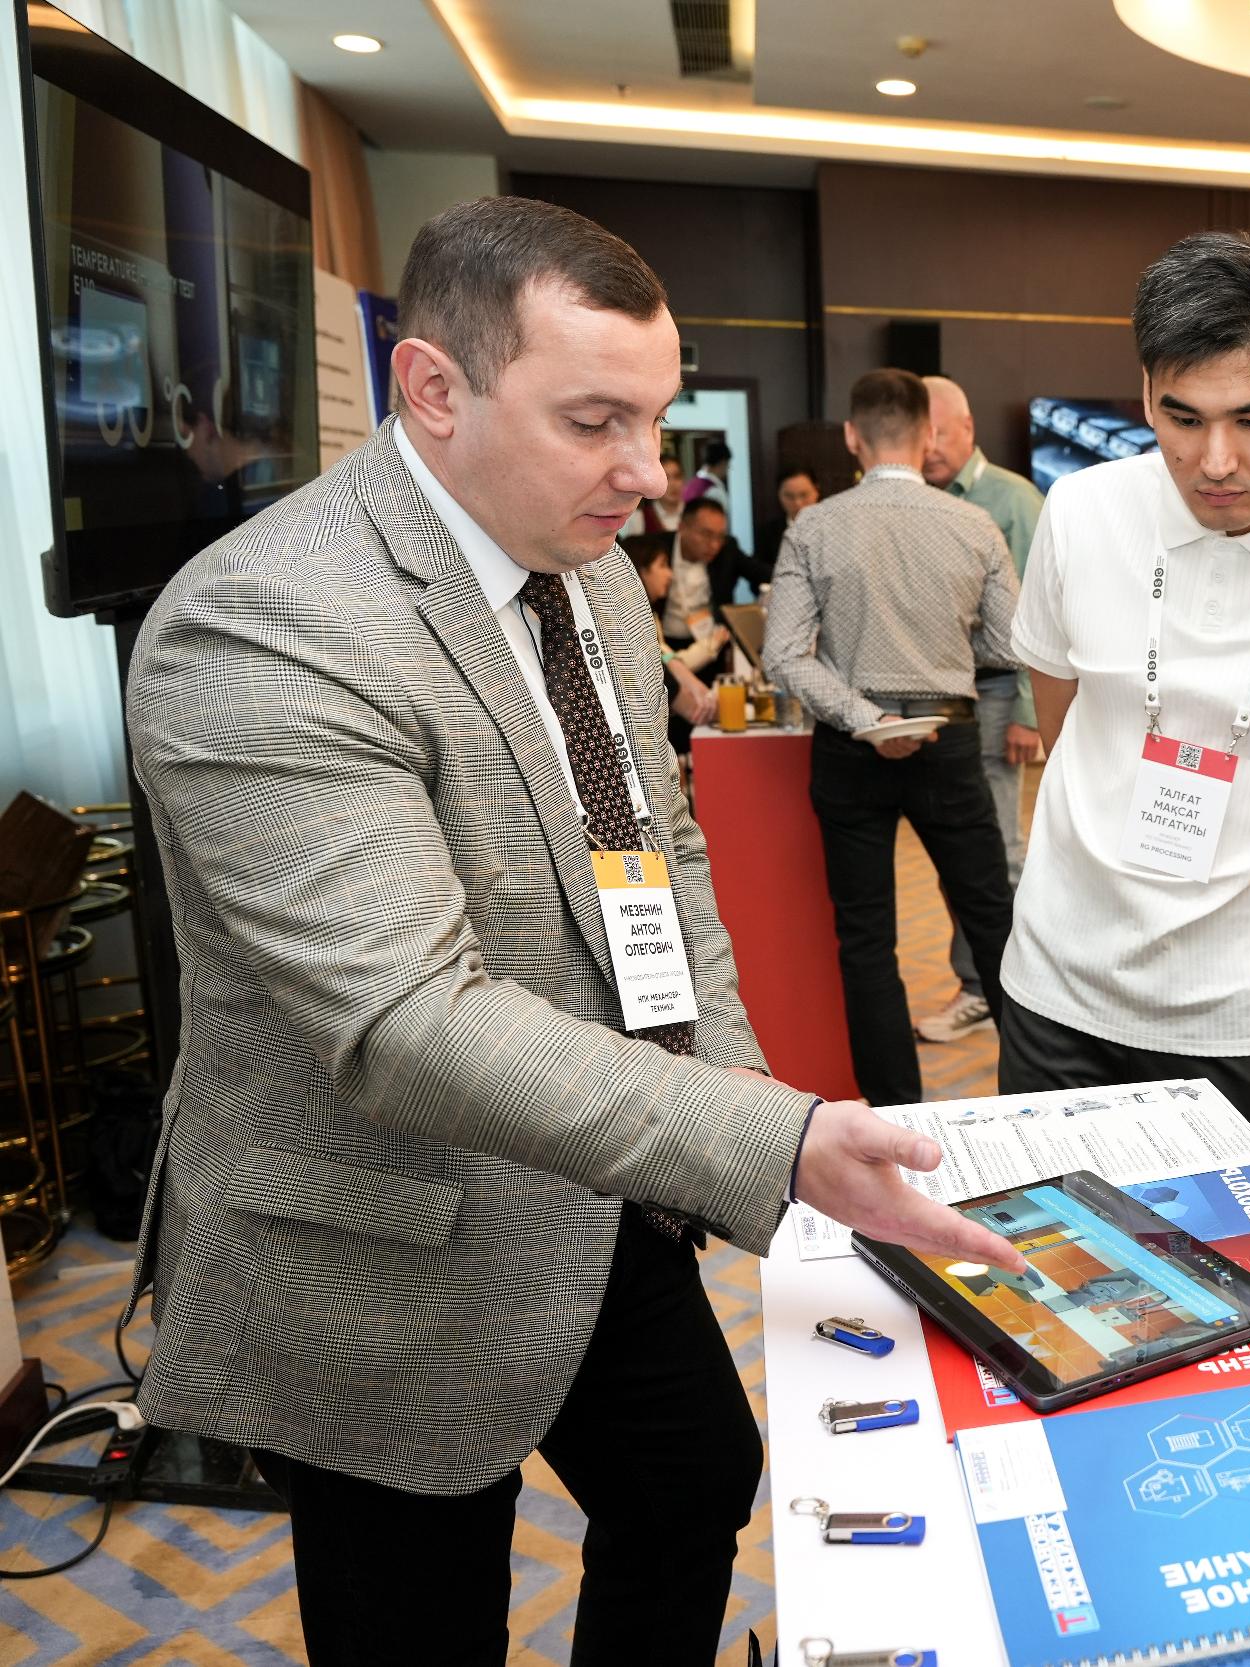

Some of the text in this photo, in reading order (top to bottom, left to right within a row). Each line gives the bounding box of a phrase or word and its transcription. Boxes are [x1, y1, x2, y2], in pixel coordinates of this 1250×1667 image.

[1152, 567, 1164, 599] BSG
[580, 628, 603, 670] BSG
[1147, 649, 1157, 682] BSG
[614, 733, 633, 774] BSG
[1151, 846, 1192, 862] PROCESSING
[620, 903, 663, 918] МЕЗЕНИН
[631, 923, 662, 937] АНТОН
[625, 941, 674, 957] ОЛЕГОВИЧ
